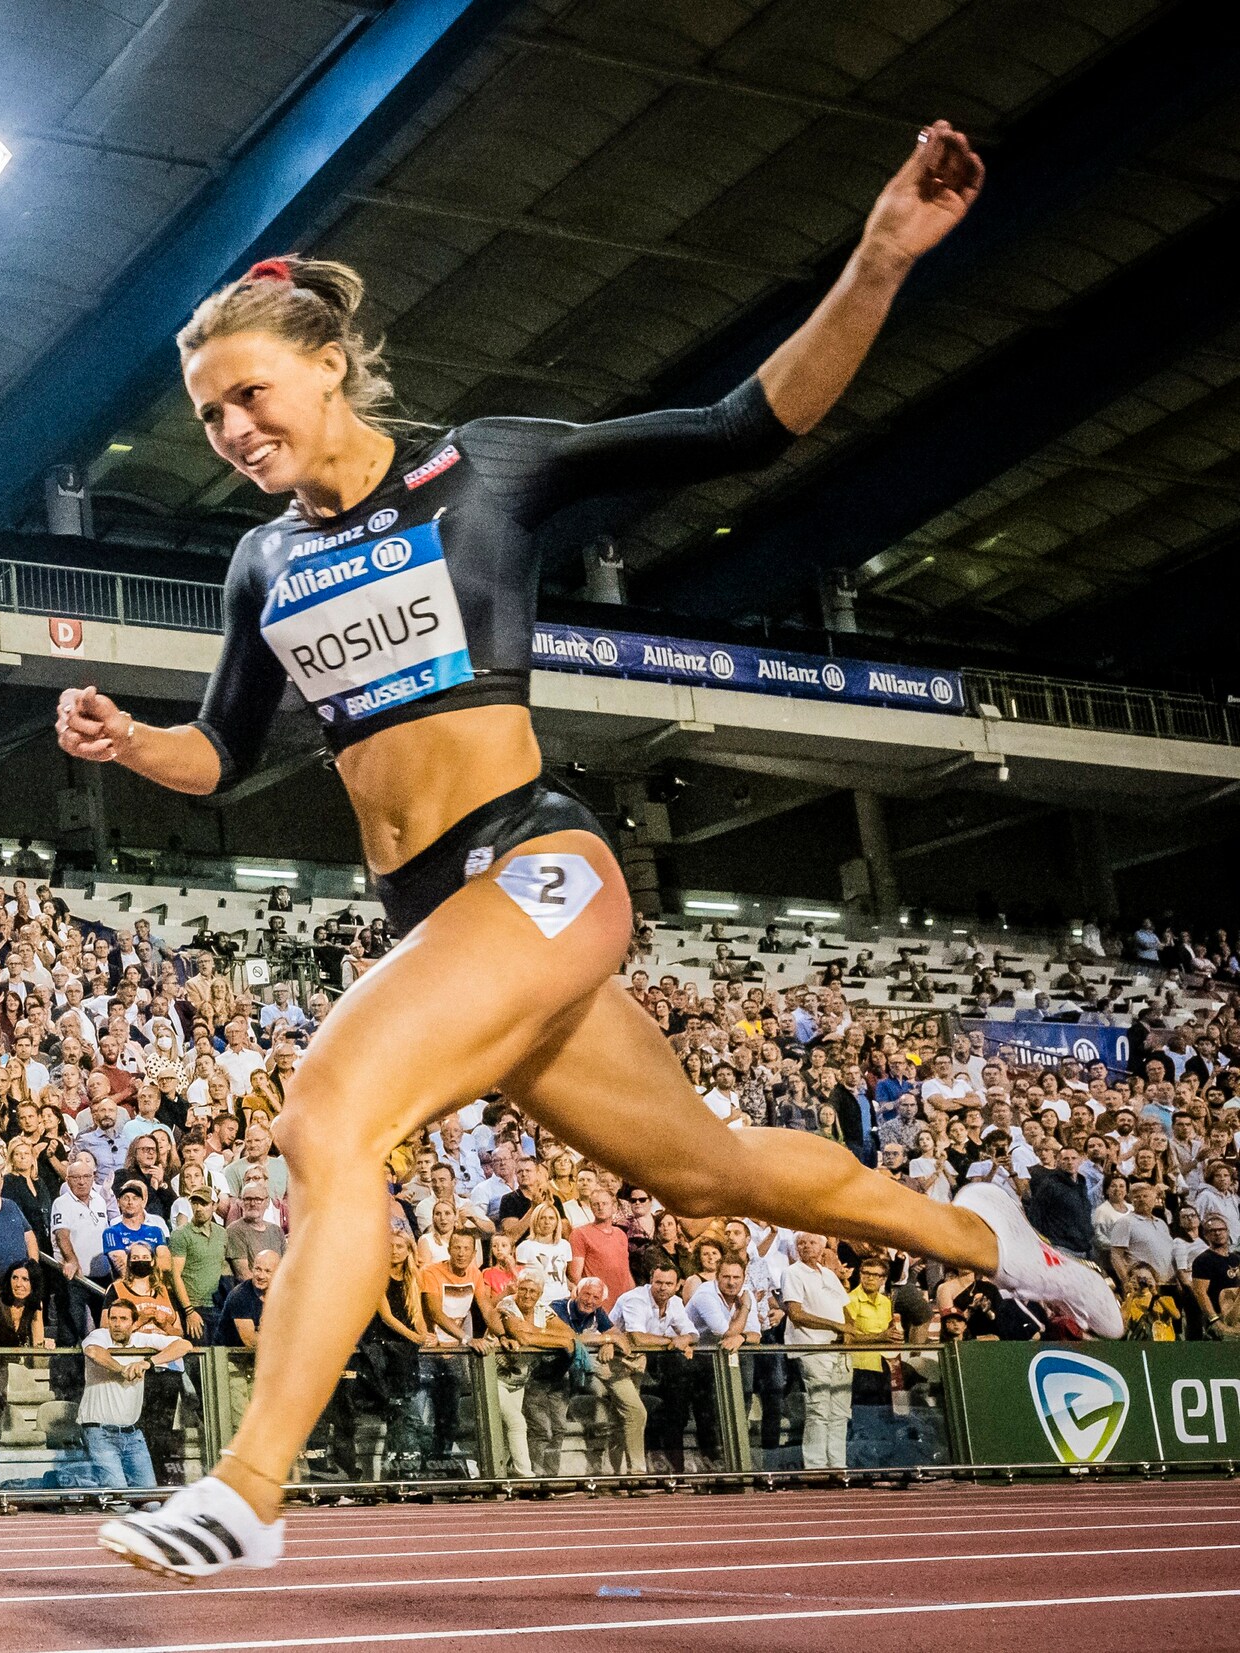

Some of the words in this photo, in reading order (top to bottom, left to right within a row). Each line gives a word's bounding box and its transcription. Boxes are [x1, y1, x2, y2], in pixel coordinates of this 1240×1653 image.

[287, 525, 364, 561] Allianz
[275, 555, 369, 608] Allianz
[58, 623, 74, 642] D
[290, 596, 440, 679] ROSIUS
[643, 645, 708, 671] Allianz
[758, 659, 820, 684] Allianz
[346, 669, 435, 716] BRUSSELS
[869, 671, 928, 698] Allianz
[539, 866, 567, 905] 2
[53, 1213, 62, 1225] 12
